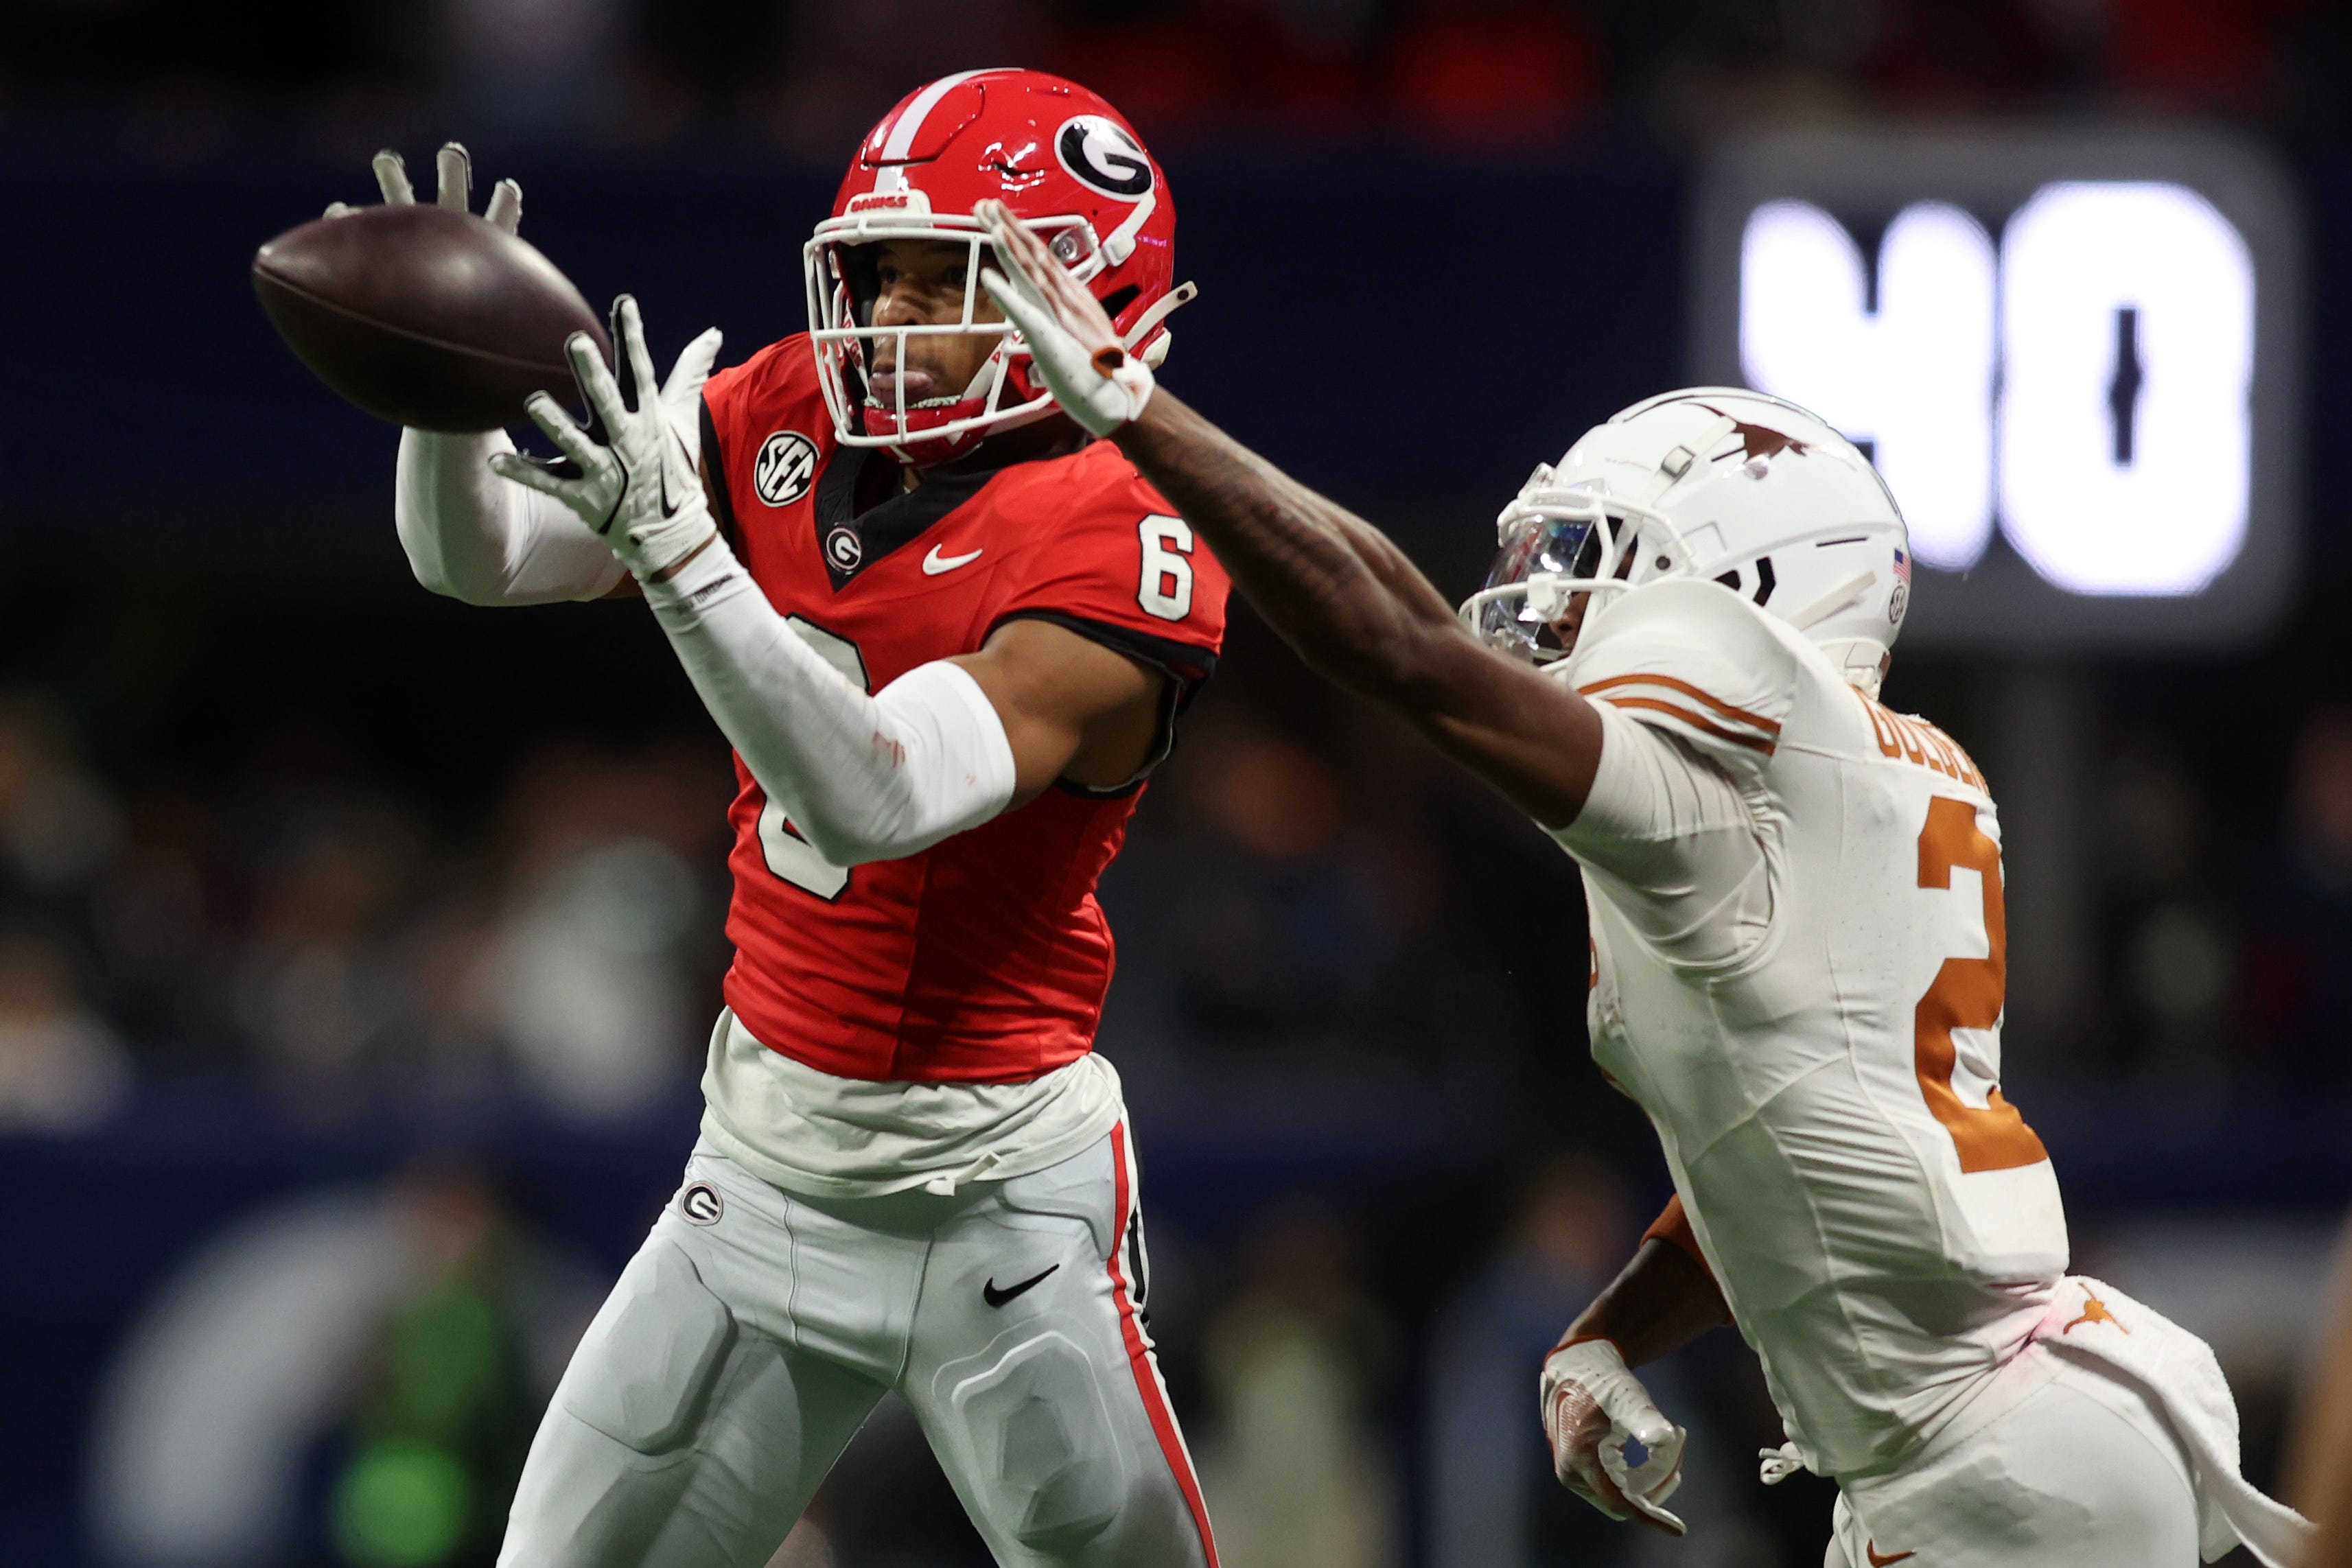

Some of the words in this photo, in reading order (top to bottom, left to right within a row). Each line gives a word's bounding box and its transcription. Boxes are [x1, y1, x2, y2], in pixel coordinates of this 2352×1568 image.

[1060, 121, 1152, 196] G
[1739, 180, 2256, 596] 40
[758, 436, 815, 502] SEC
[828, 530, 860, 569] G
[1137, 513, 1194, 622] 6
[1914, 795, 2049, 1174] 2
[683, 1186, 719, 1220] G
